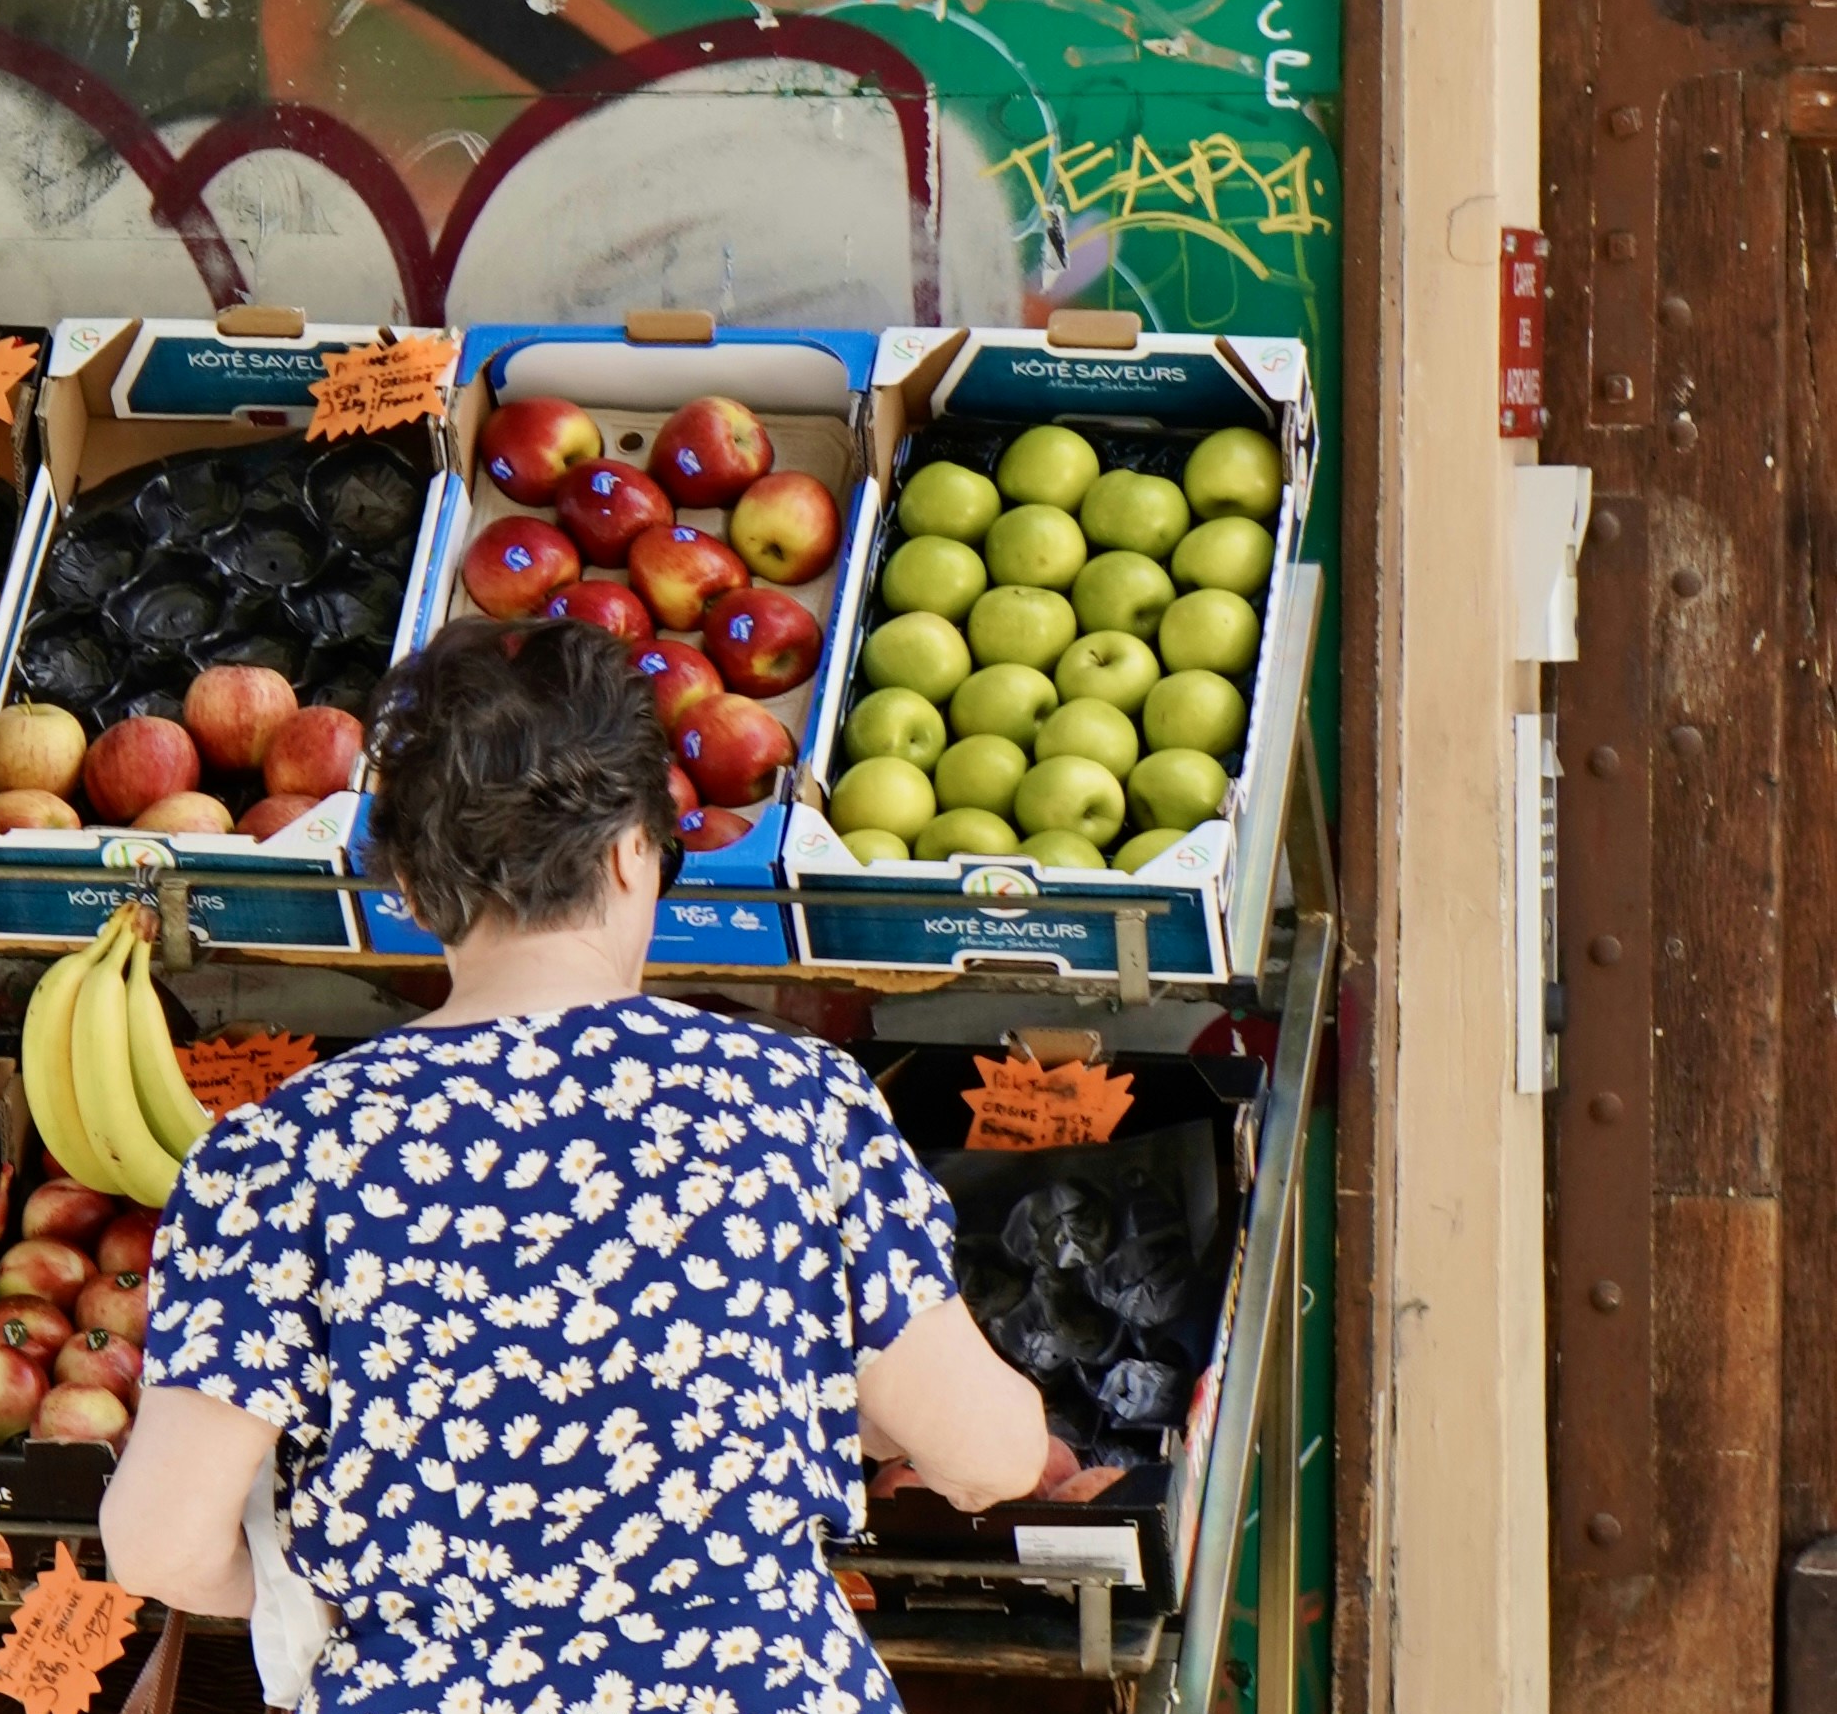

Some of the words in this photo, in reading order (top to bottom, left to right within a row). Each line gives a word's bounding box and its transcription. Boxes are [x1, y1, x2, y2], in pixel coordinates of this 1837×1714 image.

[187, 349, 245, 369] KÔTÉ
[249, 353, 325, 372] SAVEU
[1011, 358, 1073, 379] KÔTÉ
[1075, 363, 1187, 382] SAVEURS
[377, 392, 425, 412] France
[66, 887, 123, 906] KÔTÉ
[924, 916, 981, 935] KÔTÉ
[983, 920, 1088, 939] SAVEURS
[51, 1592, 82, 1641] ORIGINE
